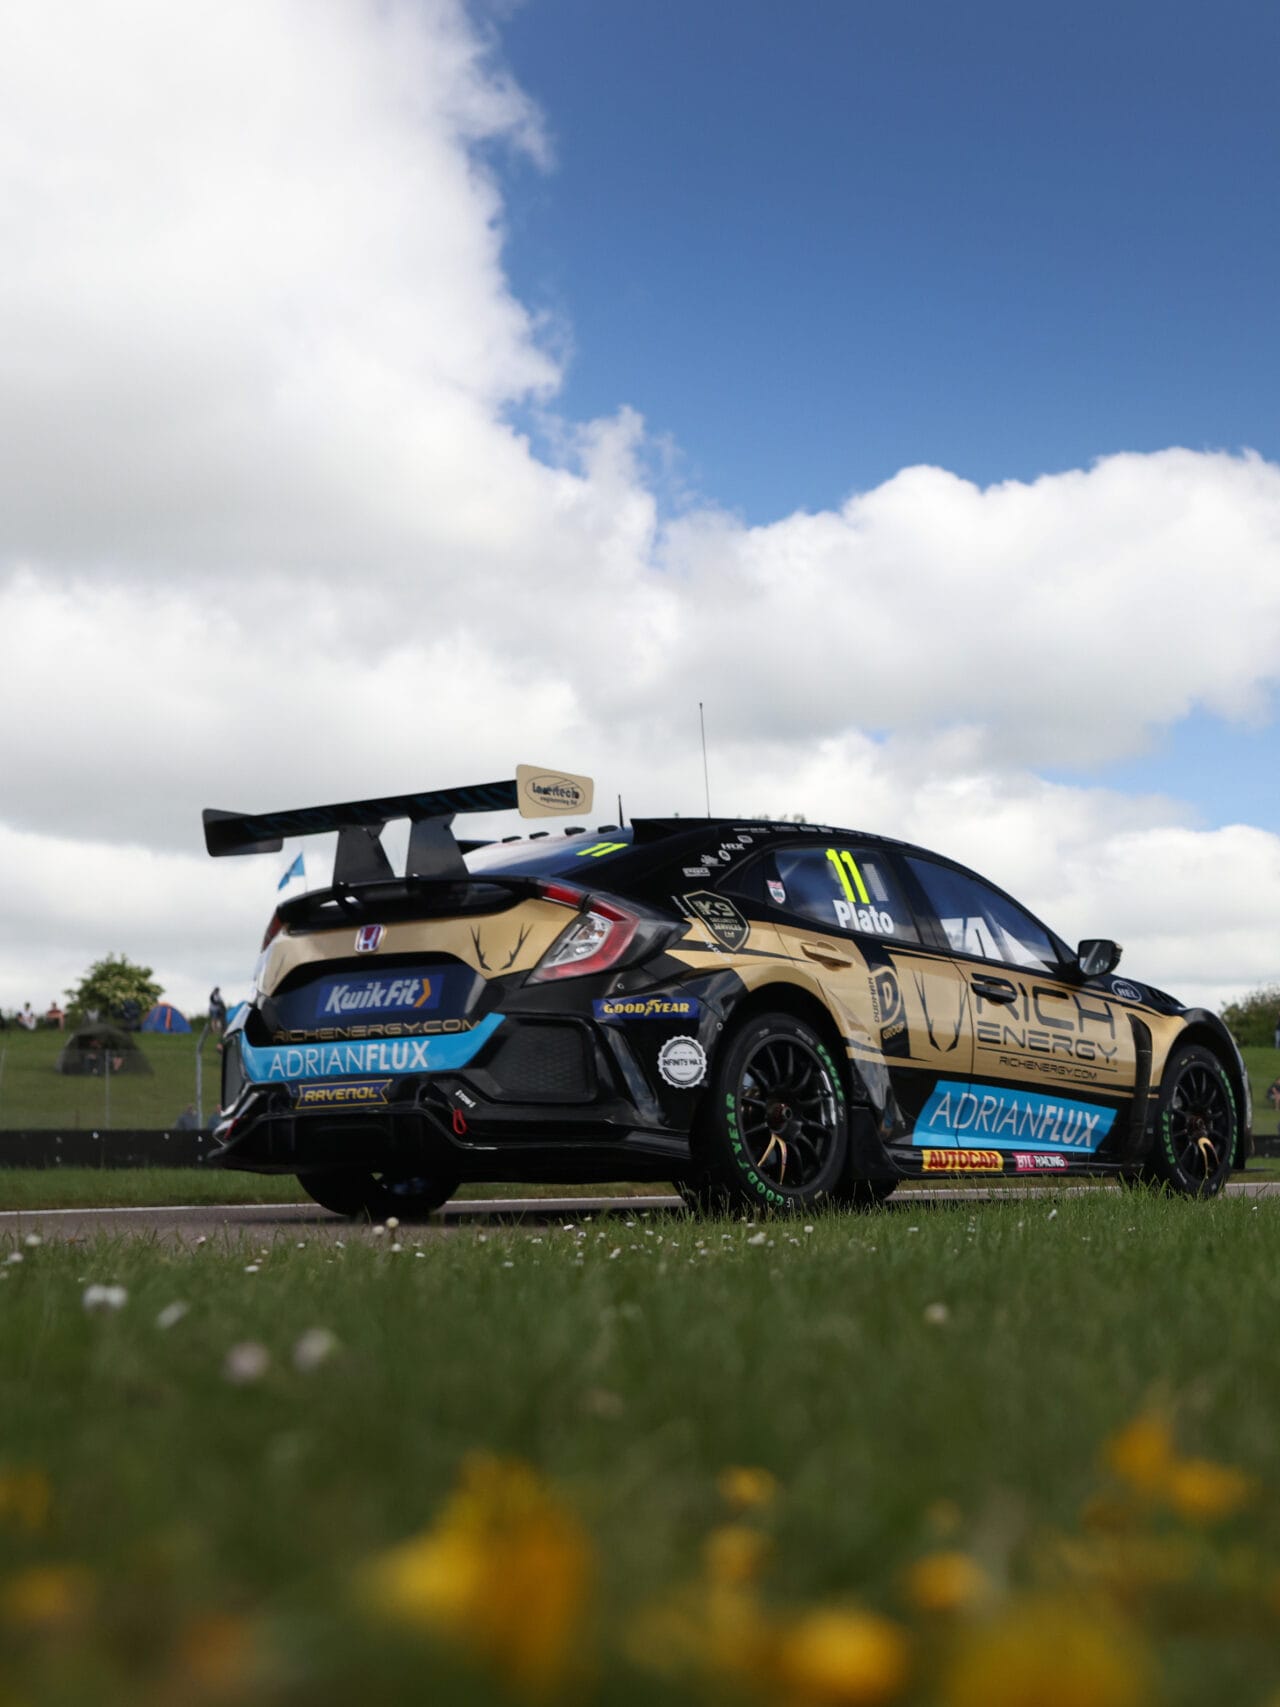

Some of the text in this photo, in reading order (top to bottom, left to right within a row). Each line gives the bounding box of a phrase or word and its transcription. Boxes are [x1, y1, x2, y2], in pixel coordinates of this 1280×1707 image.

[576, 842, 629, 858] 11
[825, 848, 870, 904] 11
[699, 901, 735, 916] K9
[832, 900, 895, 934] Plato
[1117, 987, 1138, 999] HEL
[970, 972, 1116, 1040] RICH
[273, 1018, 481, 1043] RICHENERGY.COM
[977, 1020, 1118, 1062] ENERGY
[998, 1055, 1098, 1081] RICHENERGY.COM
[304, 1086, 378, 1102] RAVENOL
[927, 1151, 999, 1169] AUTOCAR
[1033, 1155, 1066, 1168] RACING
